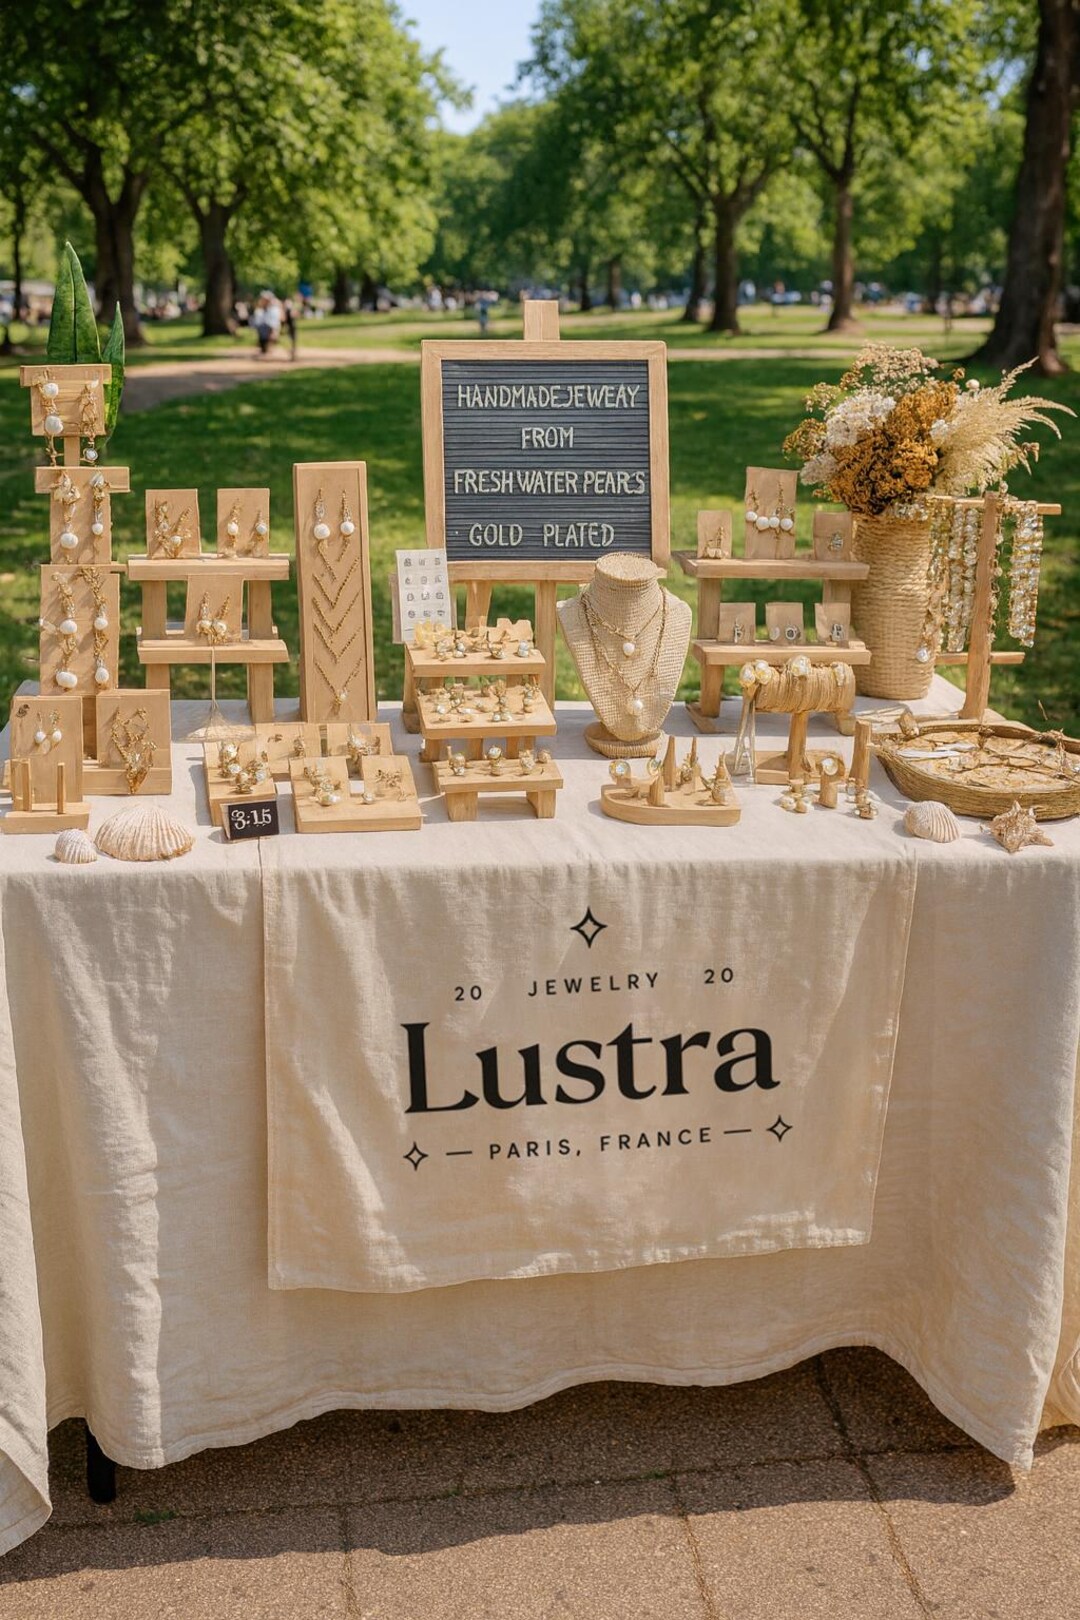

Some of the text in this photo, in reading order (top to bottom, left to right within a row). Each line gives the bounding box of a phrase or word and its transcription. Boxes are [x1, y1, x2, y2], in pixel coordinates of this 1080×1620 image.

[521, 427, 574, 449] FROM
[469, 522, 615, 547] GOLD PLATED
[454, 967, 734, 1002] 20 JEWELRY 20
[400, 1021, 782, 1114] Lustra
[489, 1127, 712, 1160] PARIS, FRANCE
